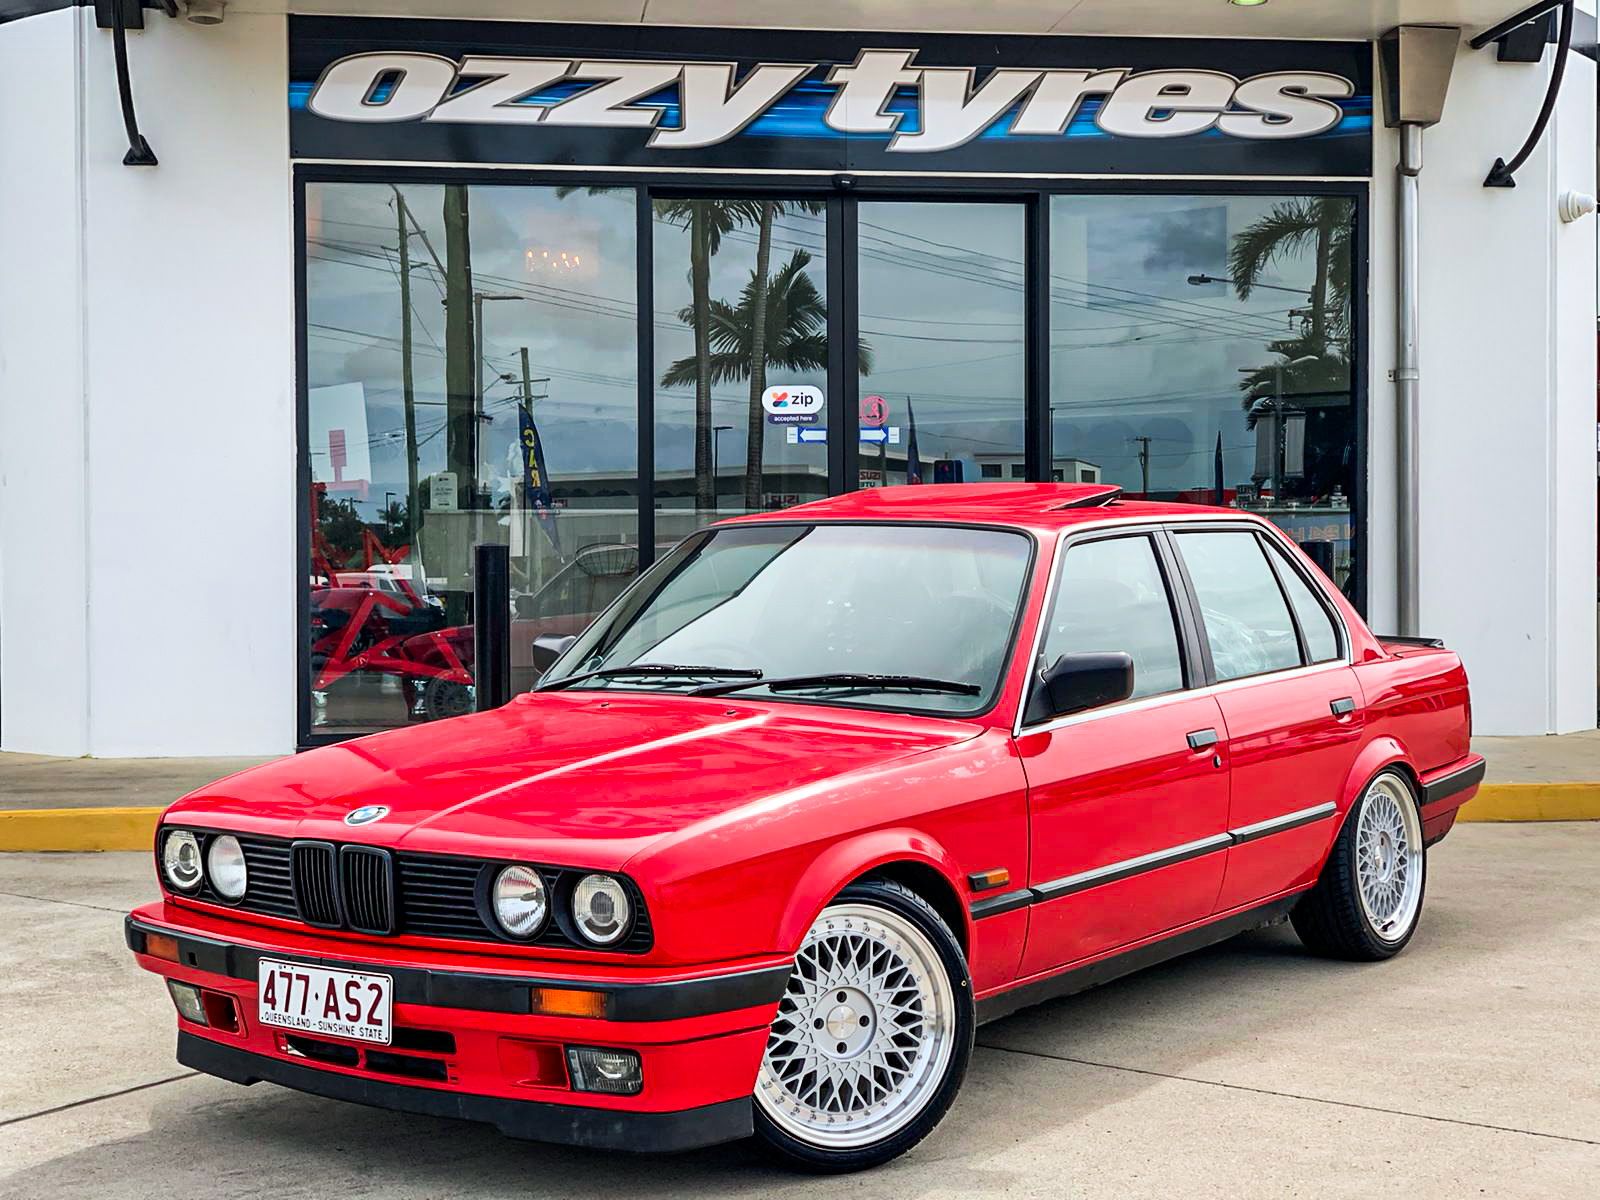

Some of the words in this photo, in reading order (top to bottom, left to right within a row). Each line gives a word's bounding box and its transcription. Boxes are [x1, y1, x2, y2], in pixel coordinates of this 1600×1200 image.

[306, 51, 817, 148] ozzy
[824, 48, 1355, 152] tyres
[791, 392, 814, 407] zip
[264, 1011, 311, 1029] QUEENSLAND
[318, 1020, 355, 1036] SUNSHINE
[359, 1027, 383, 1040] STATE
